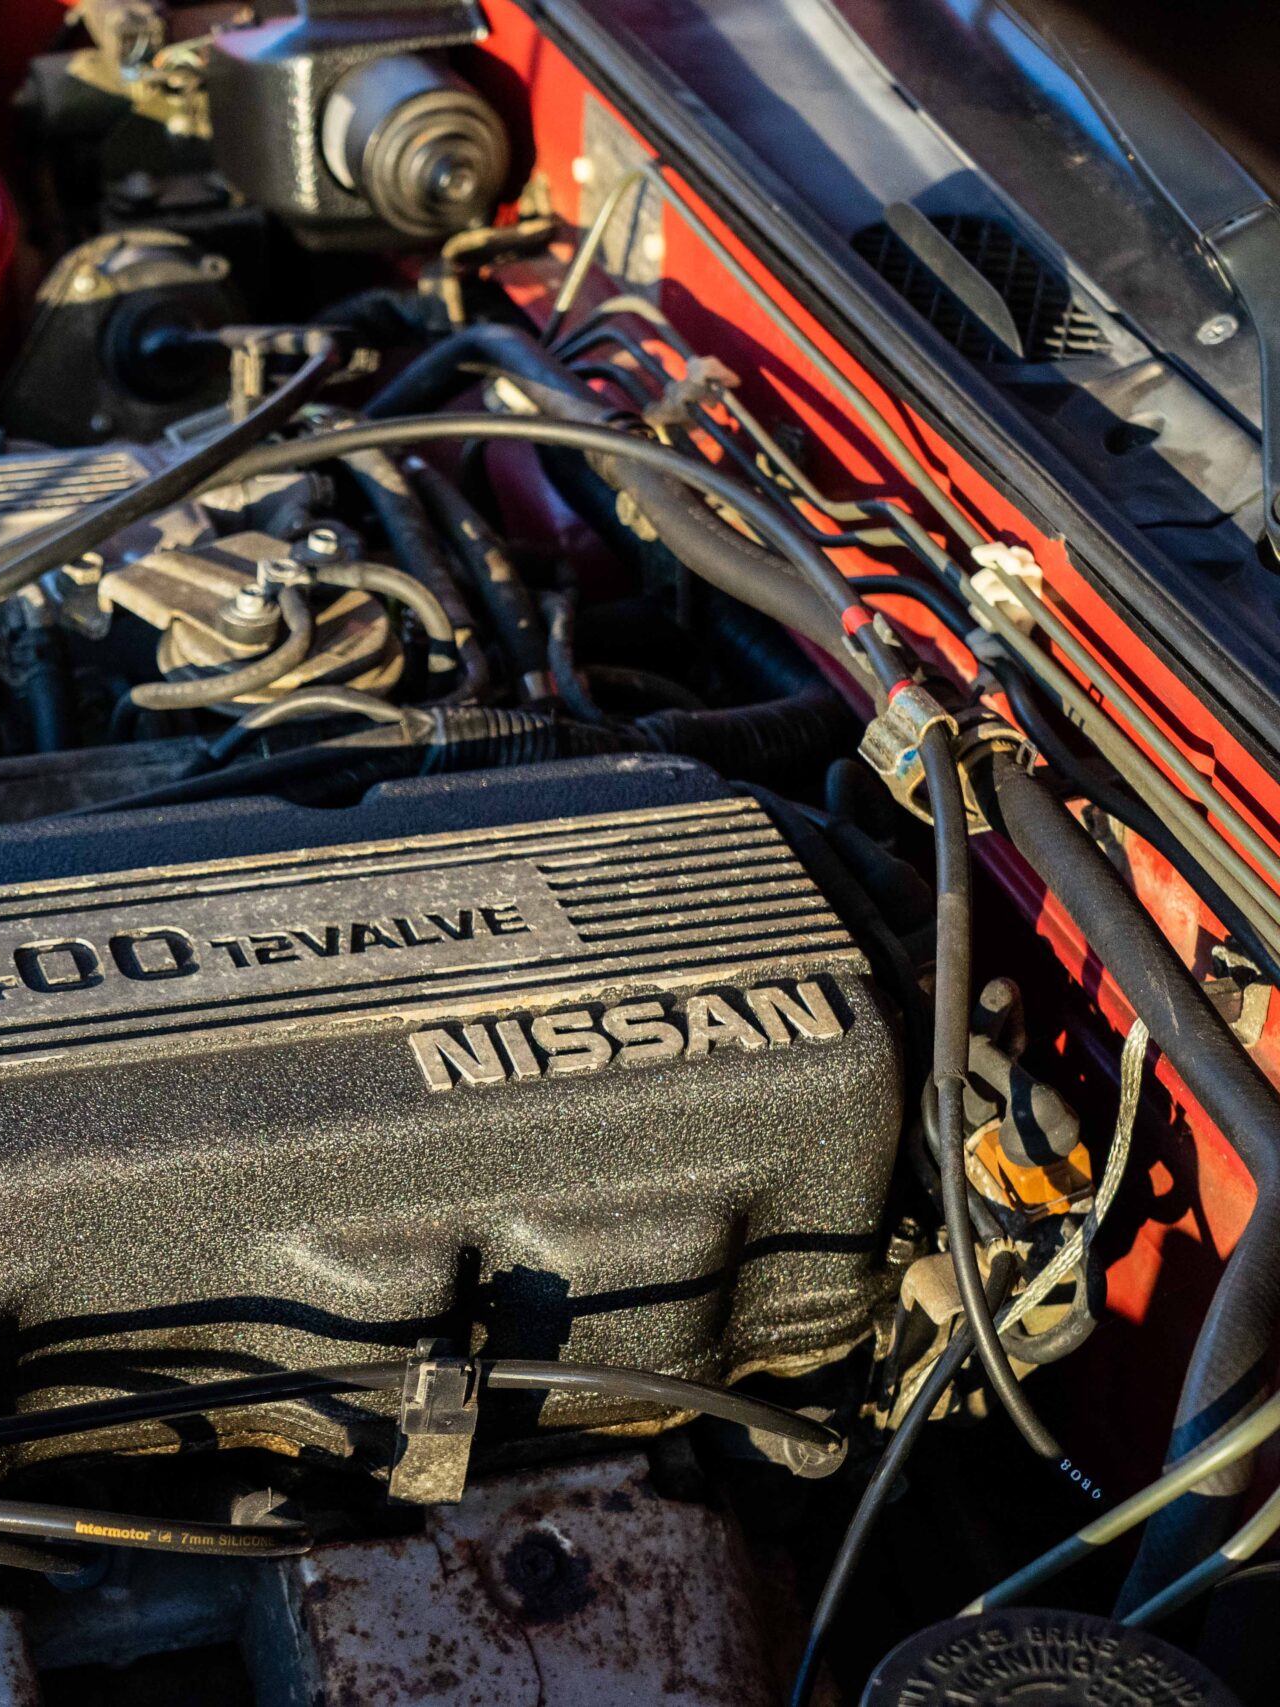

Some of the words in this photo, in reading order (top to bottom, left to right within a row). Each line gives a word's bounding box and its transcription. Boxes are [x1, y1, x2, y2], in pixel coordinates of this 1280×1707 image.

[409, 981, 845, 1091] NISSAN
[181, 1532, 214, 1546] 7mm
[1027, 1624, 1120, 1658] BRAKE
